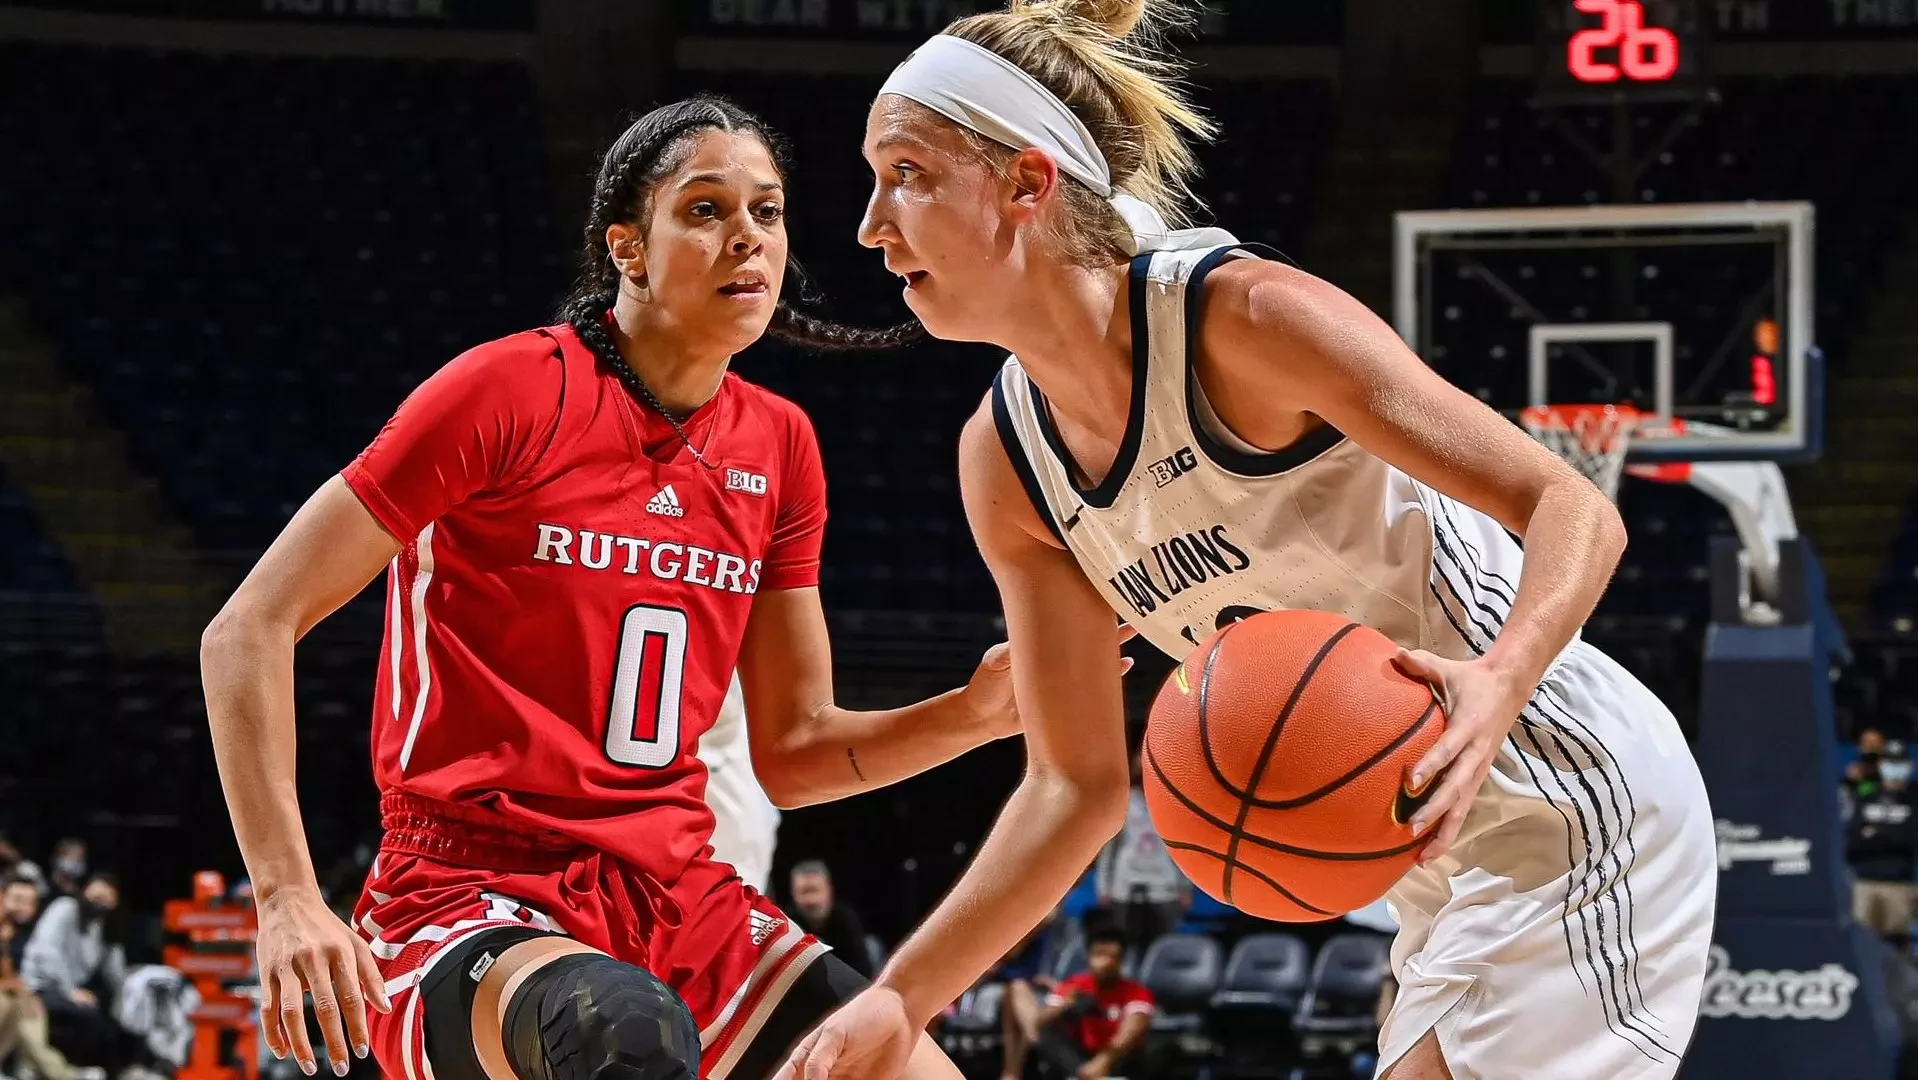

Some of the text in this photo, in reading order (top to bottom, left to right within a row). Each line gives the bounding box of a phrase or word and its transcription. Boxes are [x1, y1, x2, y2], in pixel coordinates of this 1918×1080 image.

[1567, 0, 1679, 83] 26
[646, 502, 684, 518] adidas
[533, 523, 762, 595] RUTGERS
[1150, 524, 1250, 596] LIONS
[605, 602, 688, 770] 0
[752, 917, 785, 945] adidas
